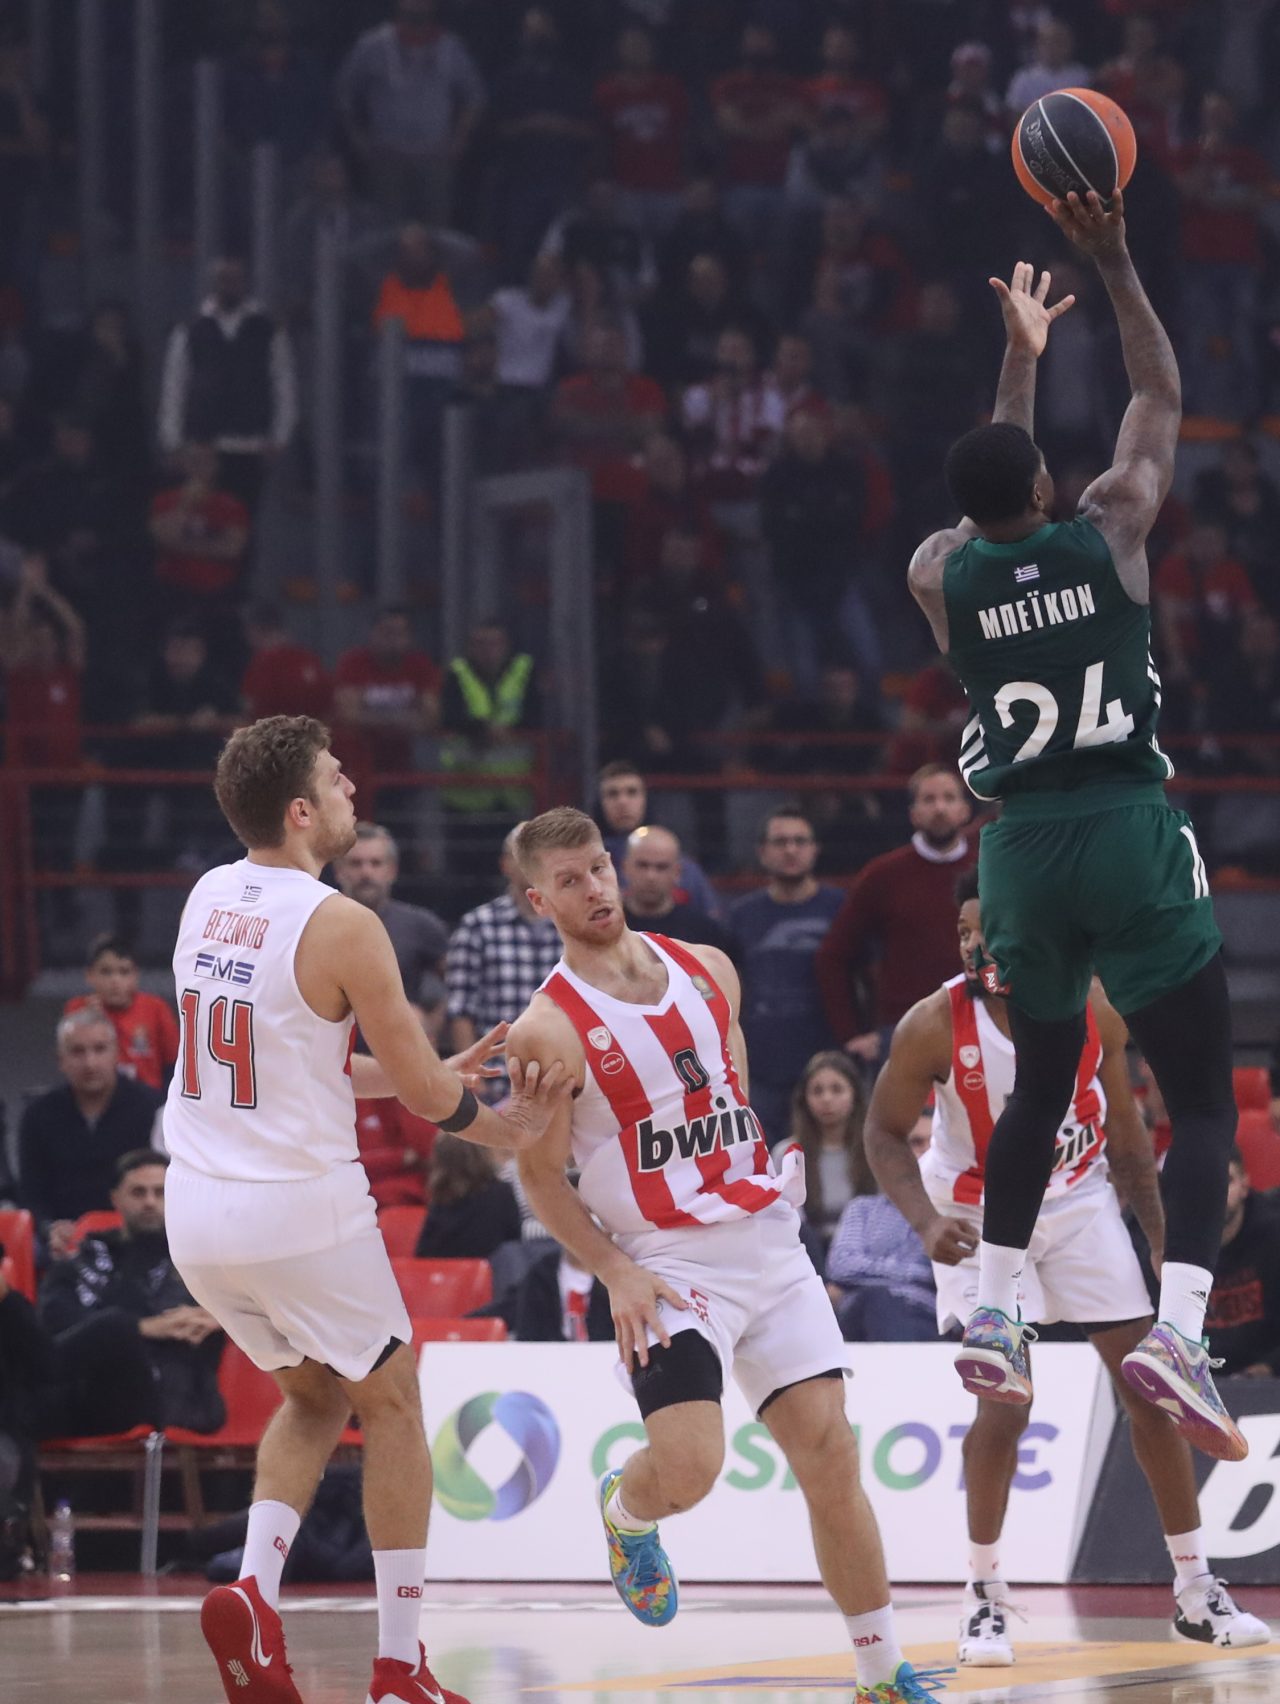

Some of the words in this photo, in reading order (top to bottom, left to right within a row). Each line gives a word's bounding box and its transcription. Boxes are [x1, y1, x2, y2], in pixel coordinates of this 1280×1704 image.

[978, 583, 1096, 640] ΜΠΕΪΚΟΝ
[993, 661, 1135, 763] 24
[194, 952, 256, 985] FMS
[181, 988, 257, 1110] 14
[673, 1048, 711, 1096] 0
[635, 1096, 762, 1173] bwin
[590, 1421, 1060, 1491] CSOE
[273, 1536, 289, 1559] GS
[397, 1586, 424, 1599] GS
